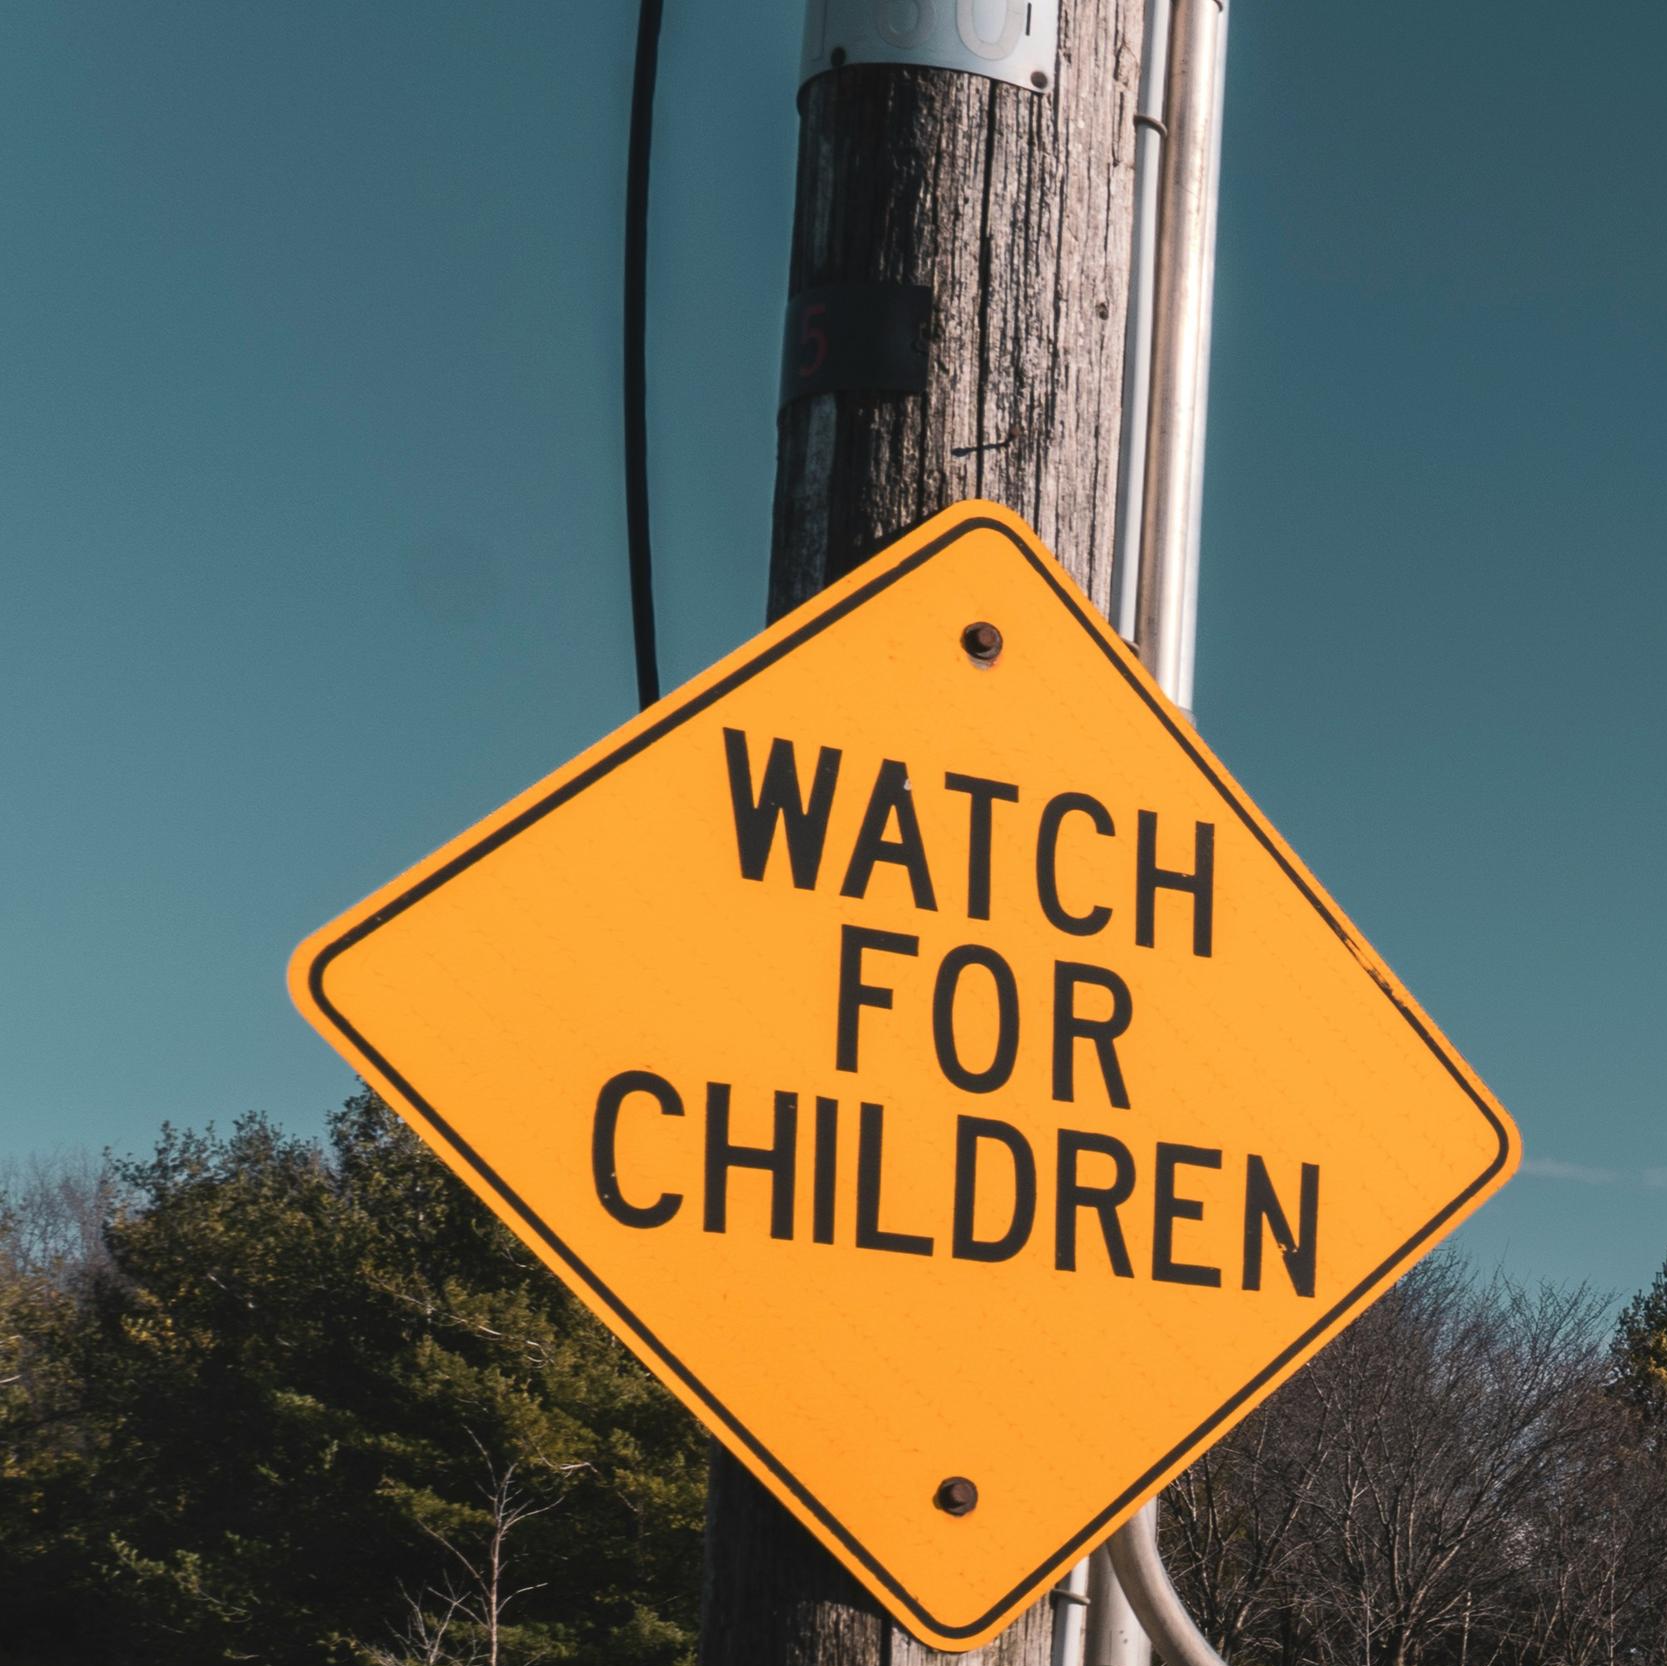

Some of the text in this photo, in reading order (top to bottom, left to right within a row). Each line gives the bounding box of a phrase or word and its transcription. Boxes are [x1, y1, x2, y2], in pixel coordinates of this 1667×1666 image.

[723, 727, 1214, 958] WATCH
[836, 924, 1133, 1110] FOR
[592, 1070, 1319, 1298] CHILDREN
